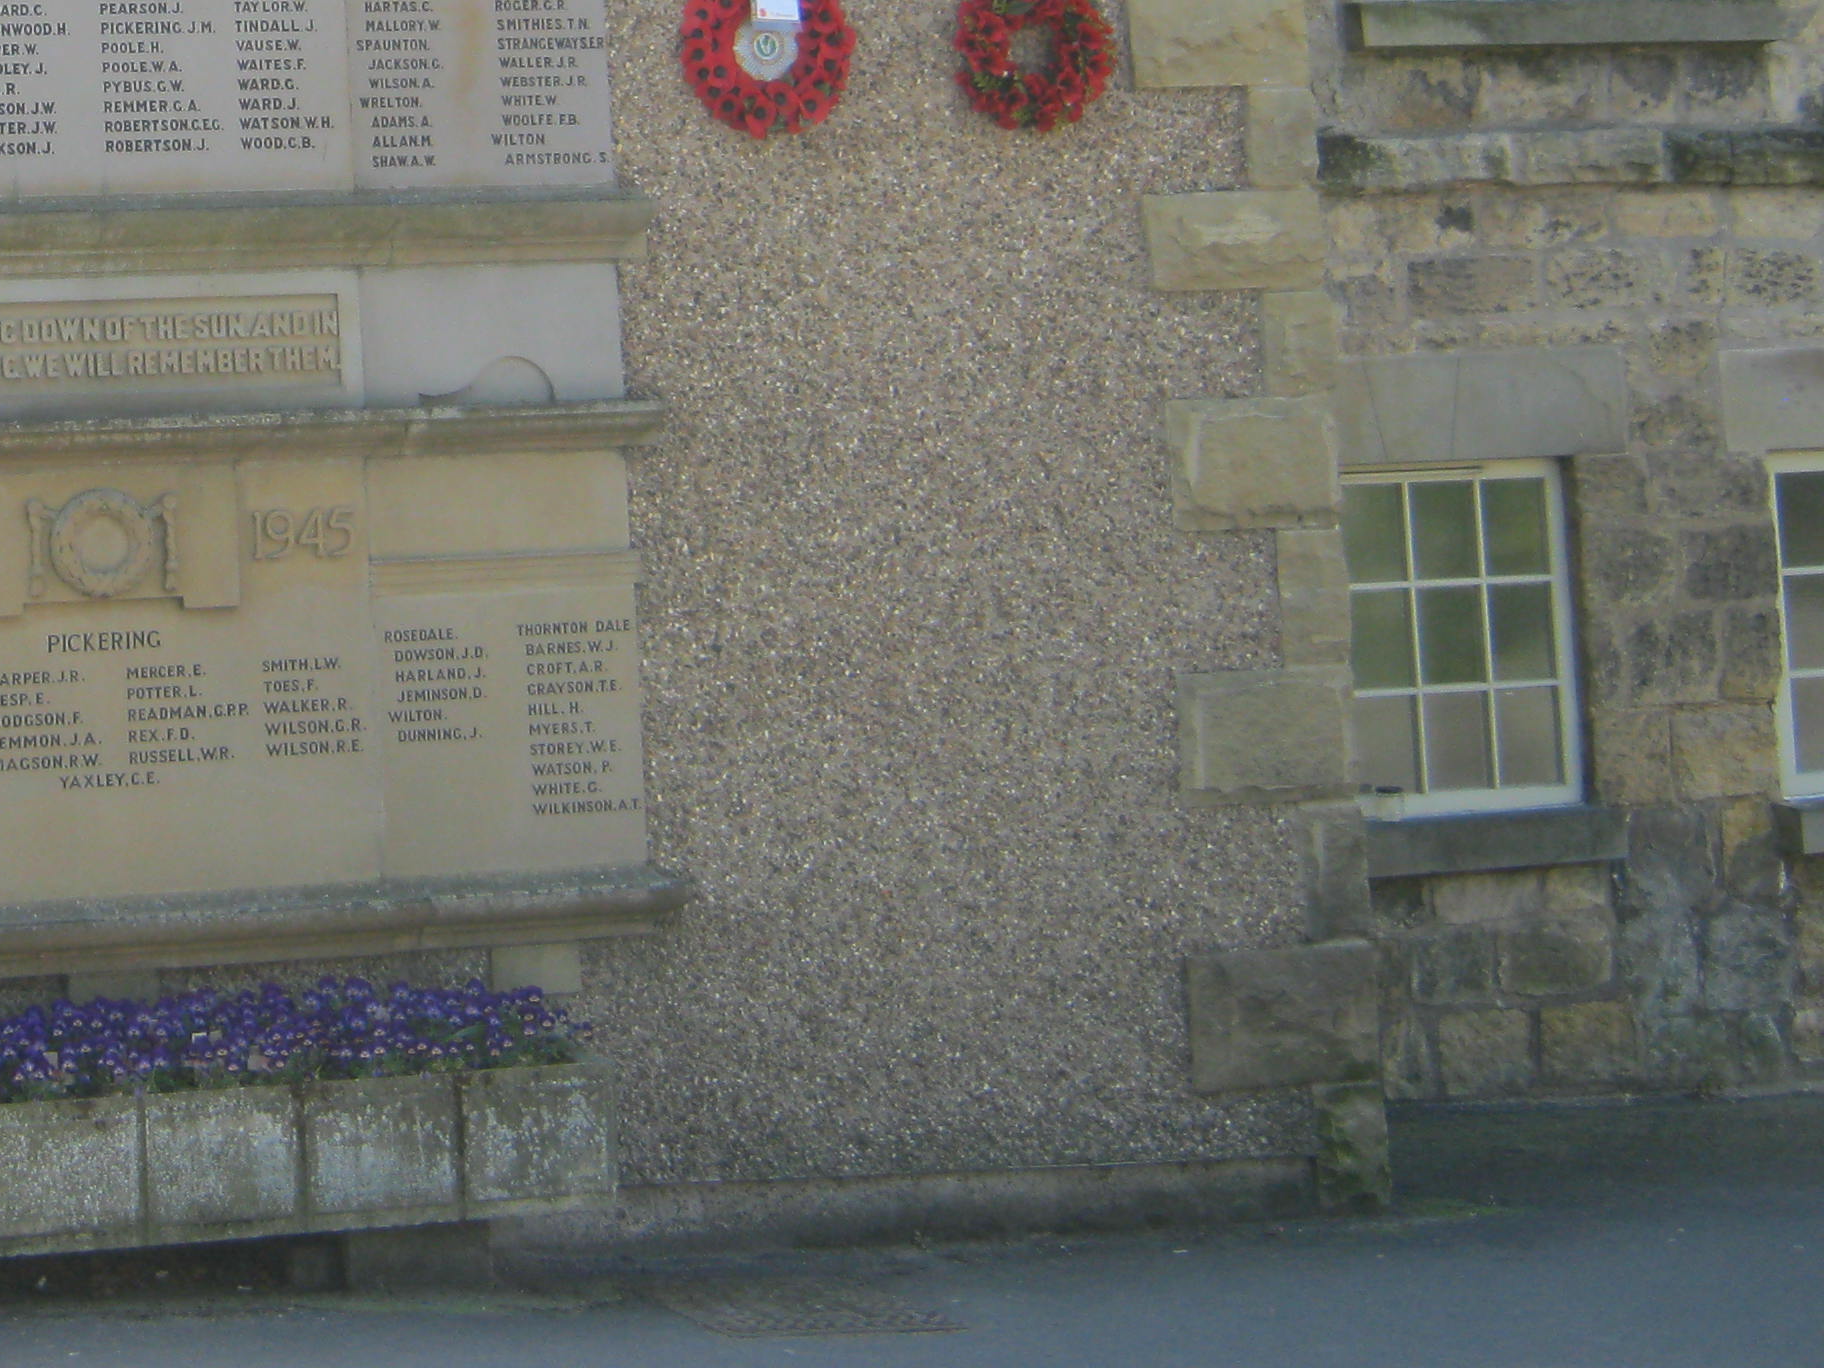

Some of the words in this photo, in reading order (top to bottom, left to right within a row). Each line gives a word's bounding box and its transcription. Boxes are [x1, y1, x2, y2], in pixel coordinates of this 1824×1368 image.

[21, 317, 100, 343] DOWN
[104, 316, 133, 341] OF
[137, 314, 189, 339] THE
[251, 311, 307, 336] AND
[312, 310, 338, 336] IN
[24, 353, 62, 378] WE
[63, 349, 123, 378] WILL
[127, 347, 263, 375] REMEMBER
[253, 506, 354, 561] 1945
[48, 630, 161, 653] PICKERING
[517, 621, 588, 636] THORNTON
[596, 619, 630, 633] DALE
